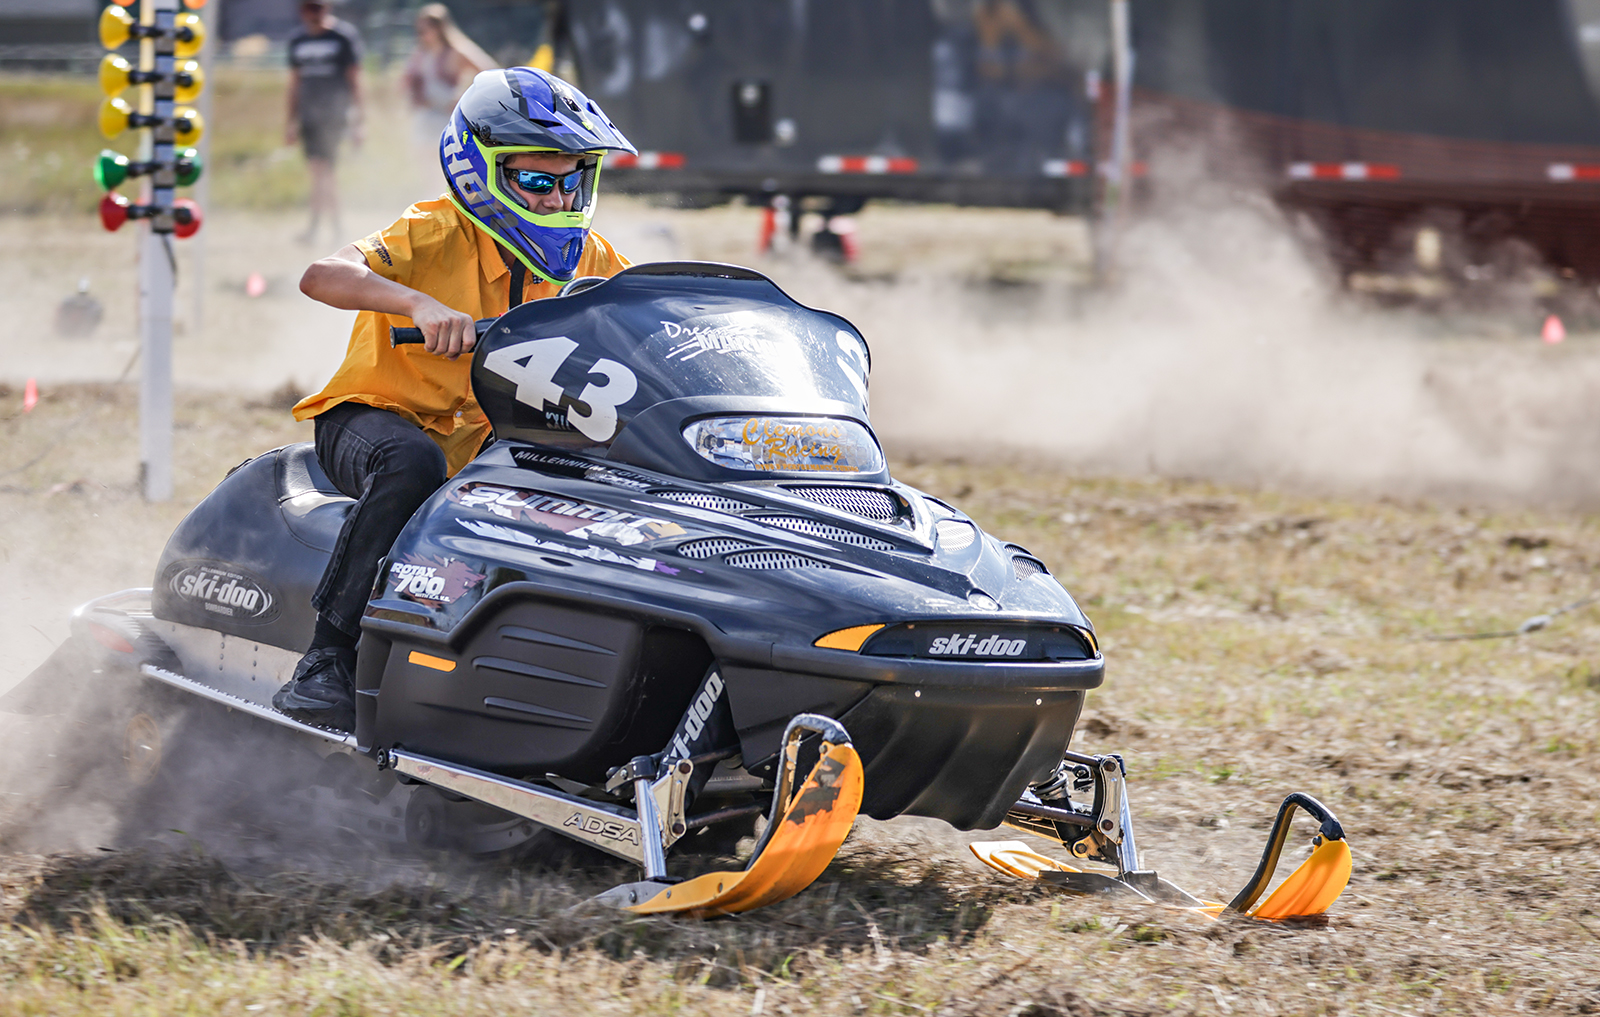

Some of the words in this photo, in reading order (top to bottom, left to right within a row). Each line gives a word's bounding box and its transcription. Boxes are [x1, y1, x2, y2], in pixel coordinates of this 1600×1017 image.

[483, 336, 639, 443] 43
[742, 418, 842, 445] Clemons
[515, 450, 607, 472] MILLENNIUM
[764, 437, 842, 464] Racing
[390, 562, 437, 577] ROTAX
[180, 572, 259, 611] ski-doo
[394, 574, 445, 595] 700
[928, 633, 1027, 656] ski-doo
[563, 811, 639, 846] ADSA
